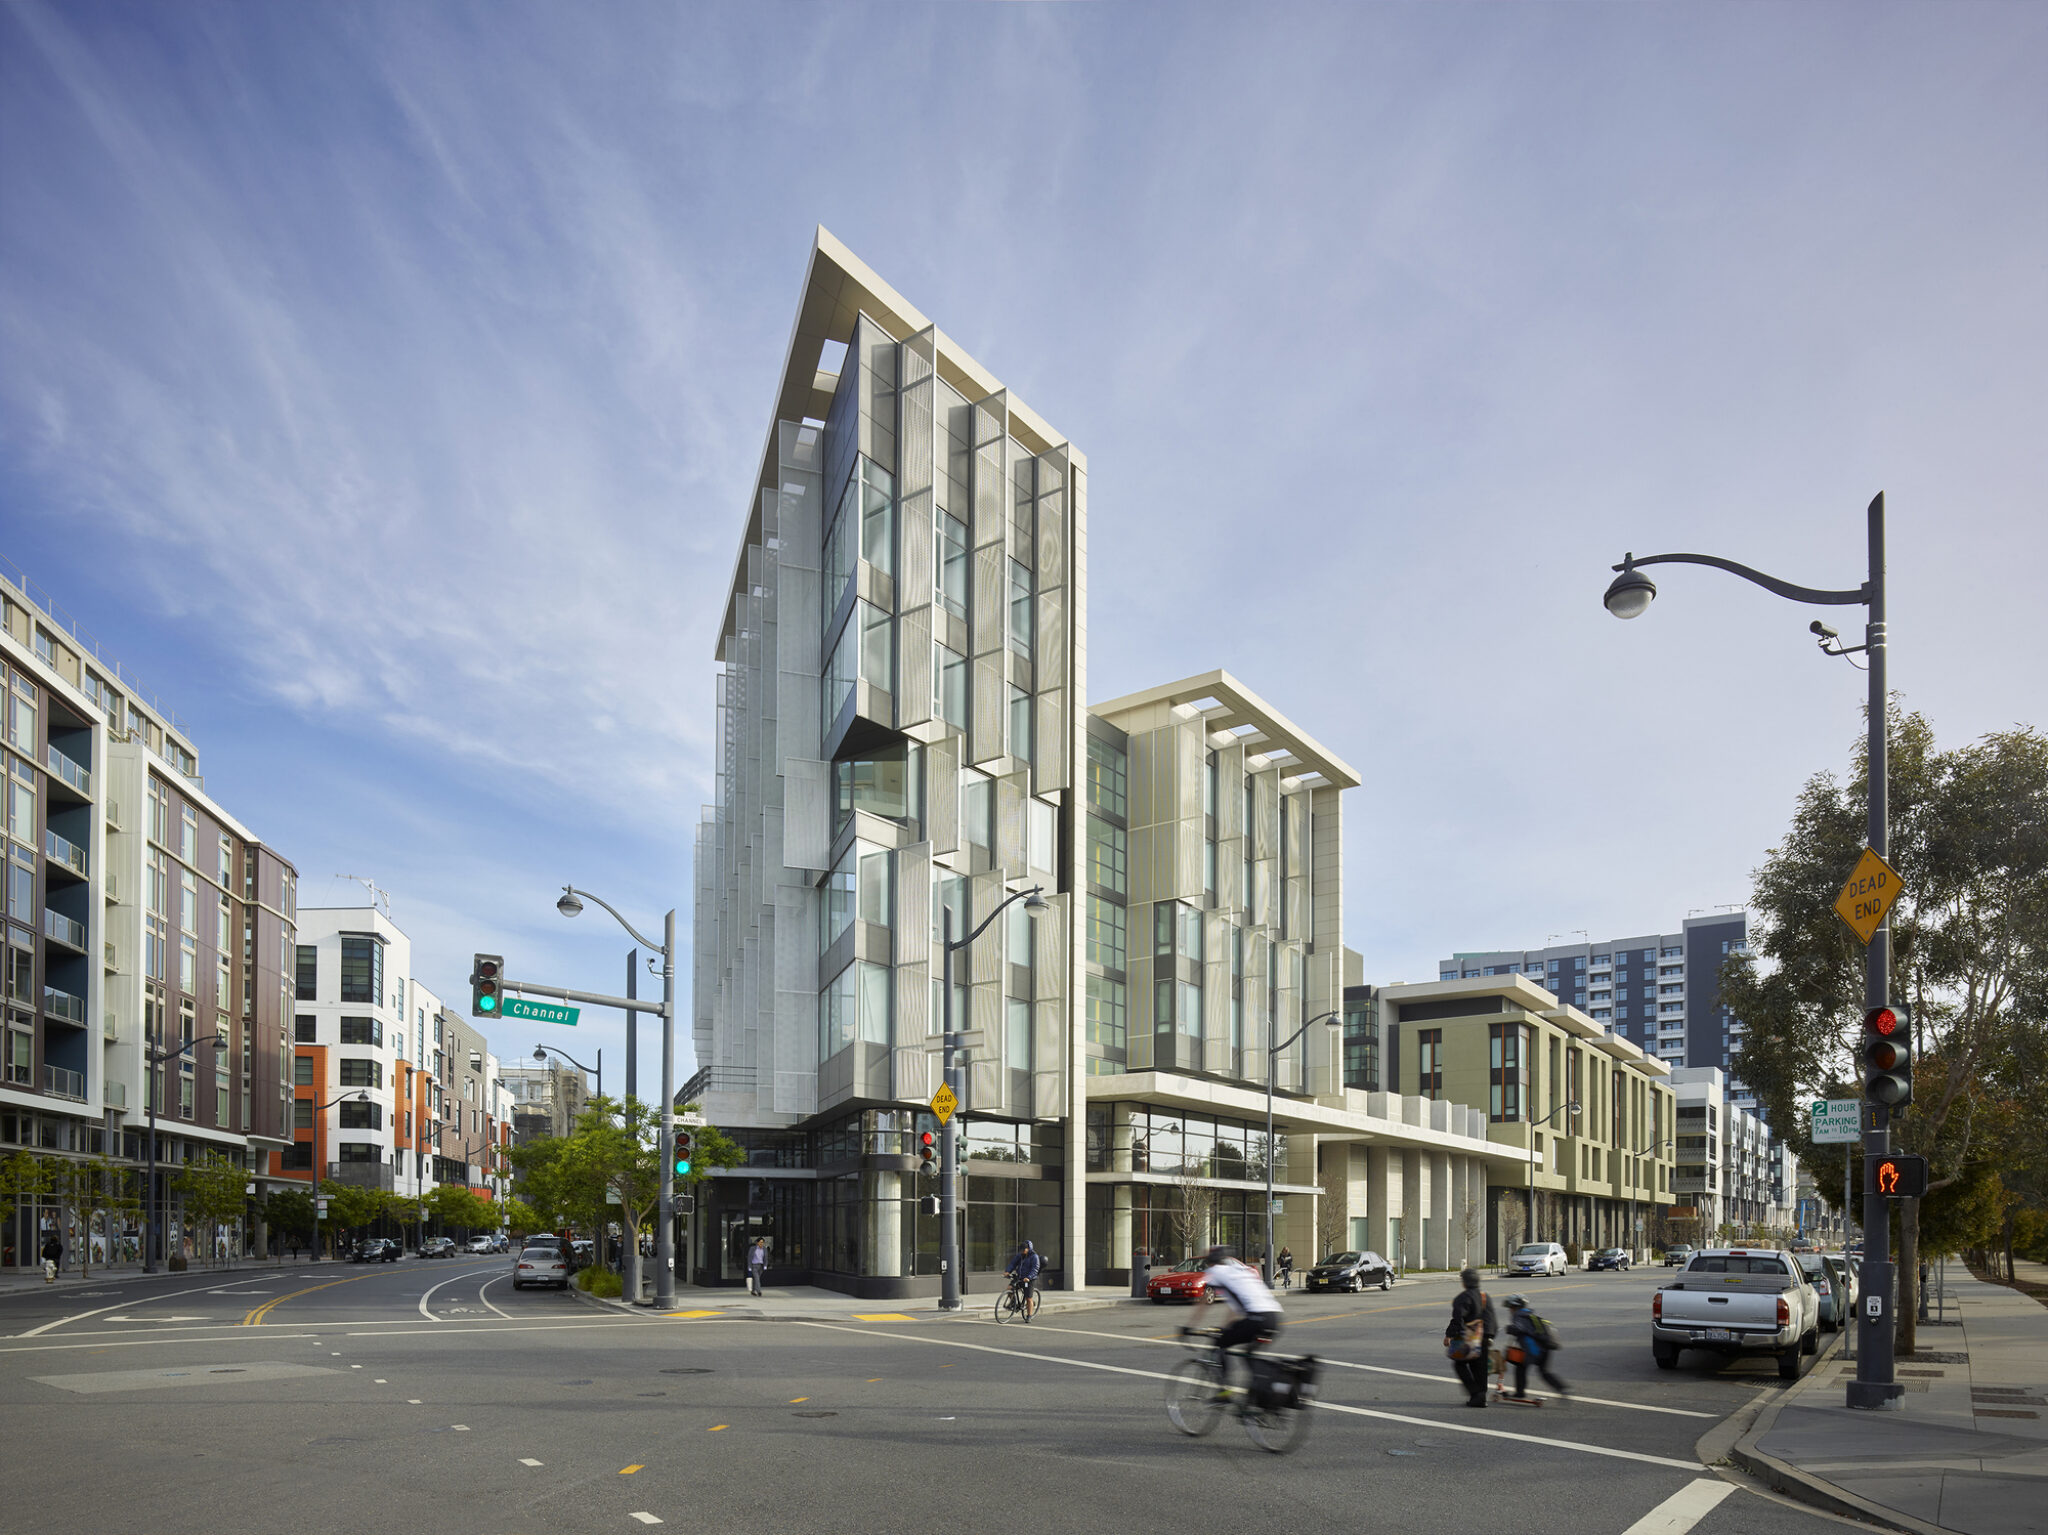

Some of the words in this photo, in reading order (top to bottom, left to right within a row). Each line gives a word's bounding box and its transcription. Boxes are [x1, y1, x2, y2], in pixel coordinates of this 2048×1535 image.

[1850, 872, 1886, 898] DEAD
[1855, 898, 1881, 920] END
[513, 1003, 569, 1021] Channel
[936, 1095, 952, 1103] DEAD
[1815, 1102, 1826, 1115] 2
[1831, 1103, 1856, 1112] HOUR
[676, 1116, 703, 1125] CHANNEL
[1815, 1117, 1858, 1126] PARKING
[1814, 1126, 1829, 1134] 7AM
[1839, 1125, 1859, 1134] 10PM
